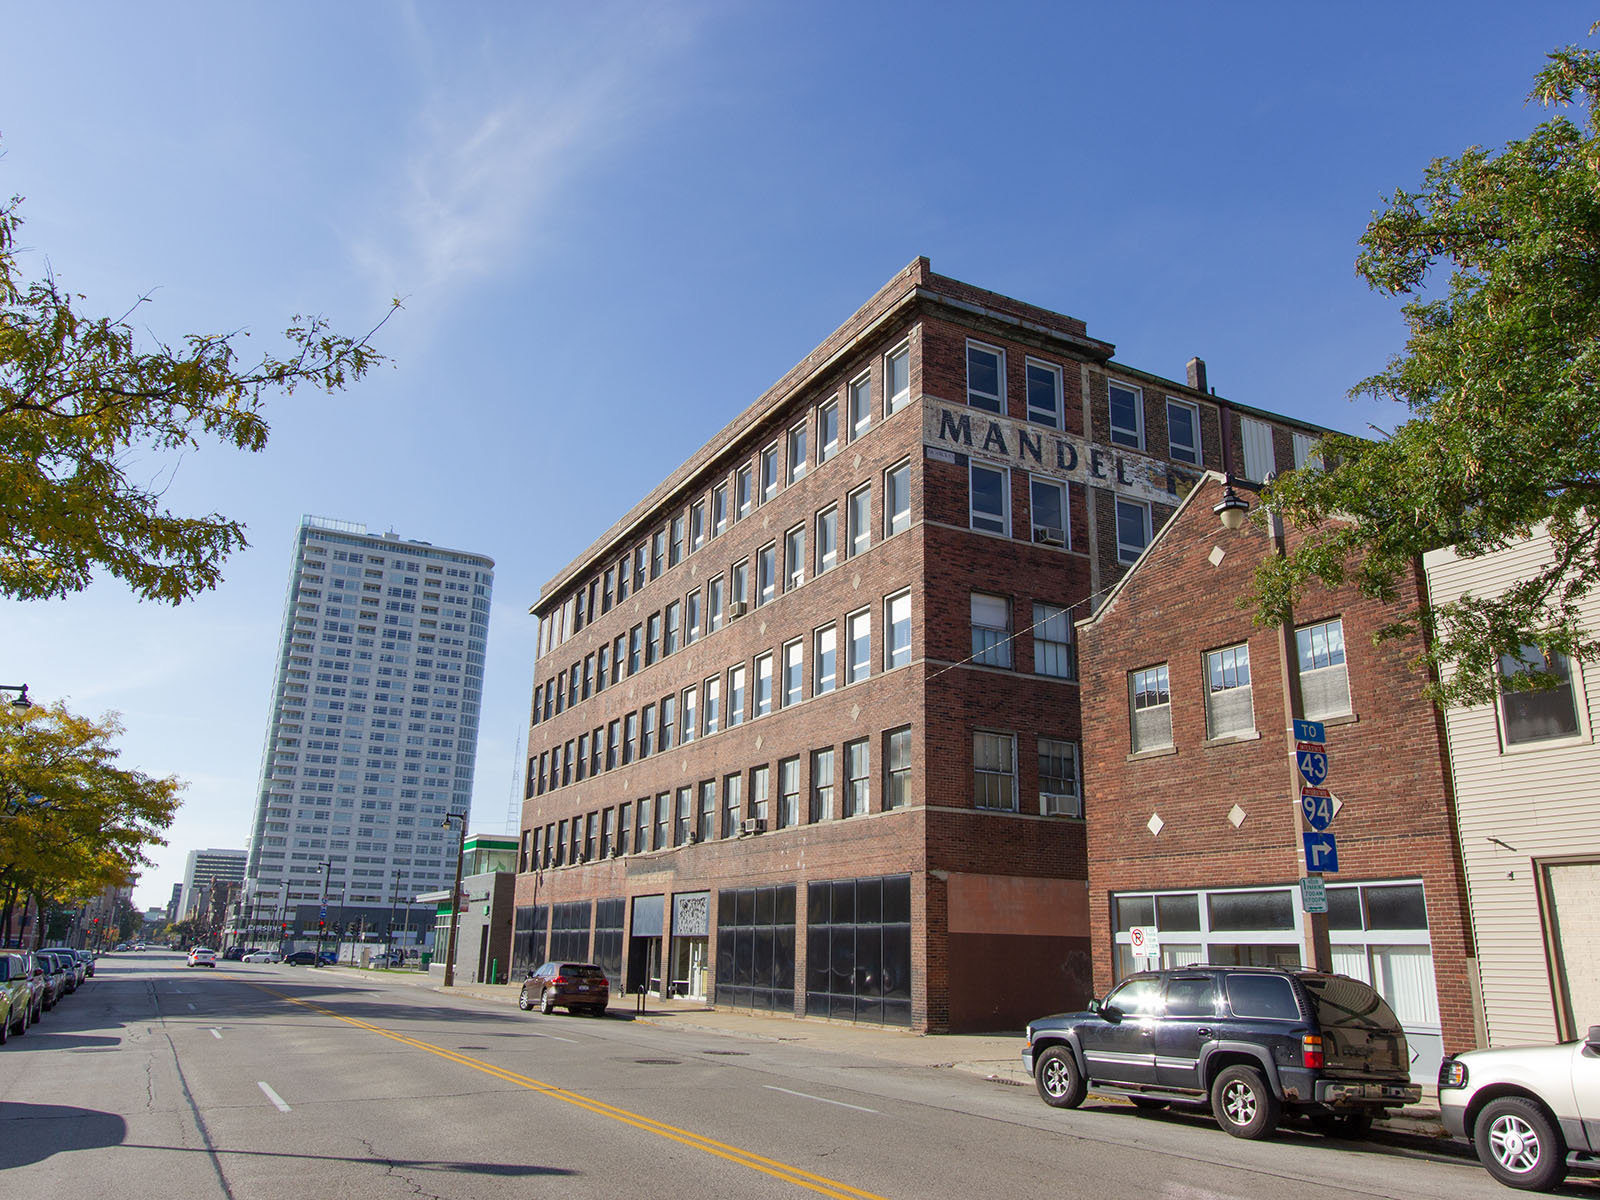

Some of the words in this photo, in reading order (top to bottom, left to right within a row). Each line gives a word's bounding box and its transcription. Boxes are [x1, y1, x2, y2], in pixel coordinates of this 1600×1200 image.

[938, 408, 1134, 486] MANDEL
[1301, 724, 1317, 738] TO
[1301, 753, 1326, 779] 43
[1303, 797, 1330, 823] 94
